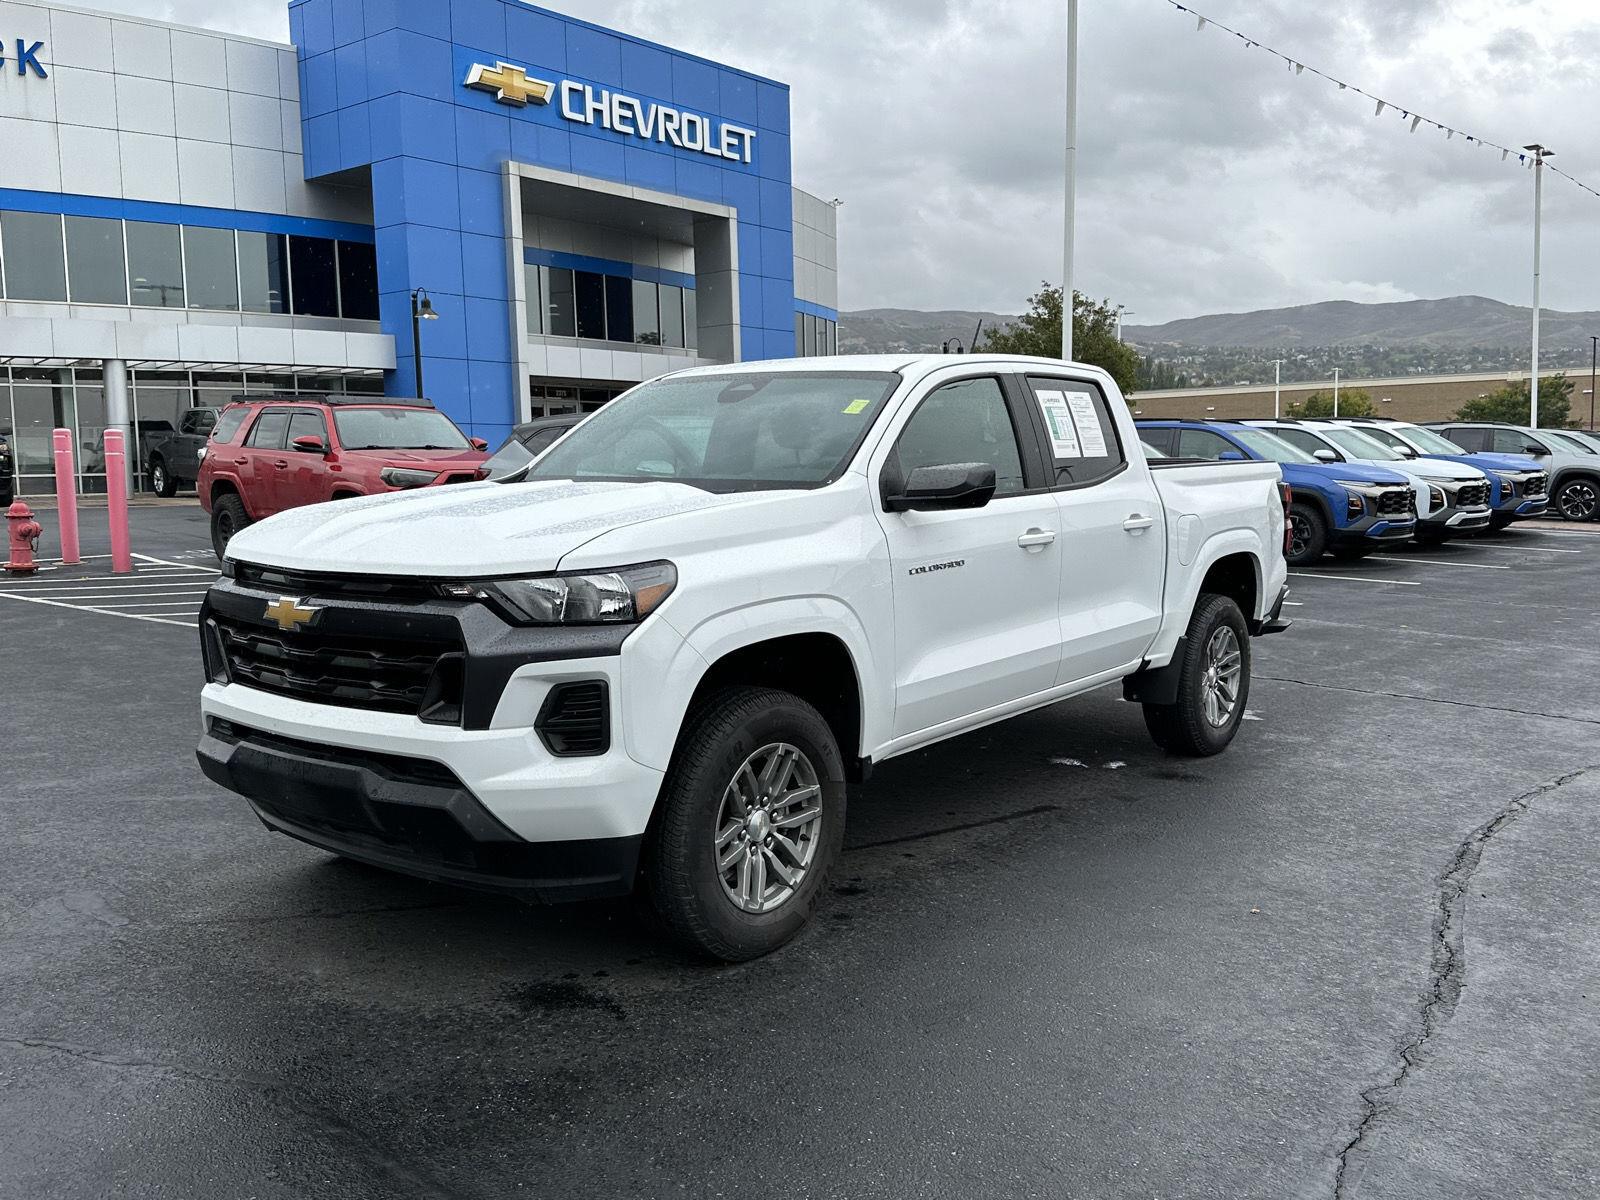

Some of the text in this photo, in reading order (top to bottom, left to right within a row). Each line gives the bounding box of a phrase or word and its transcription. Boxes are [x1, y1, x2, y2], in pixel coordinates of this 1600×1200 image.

[0, 38, 48, 79] K
[560, 79, 756, 163] CHEVROLET
[909, 560, 965, 575] COLORADO
